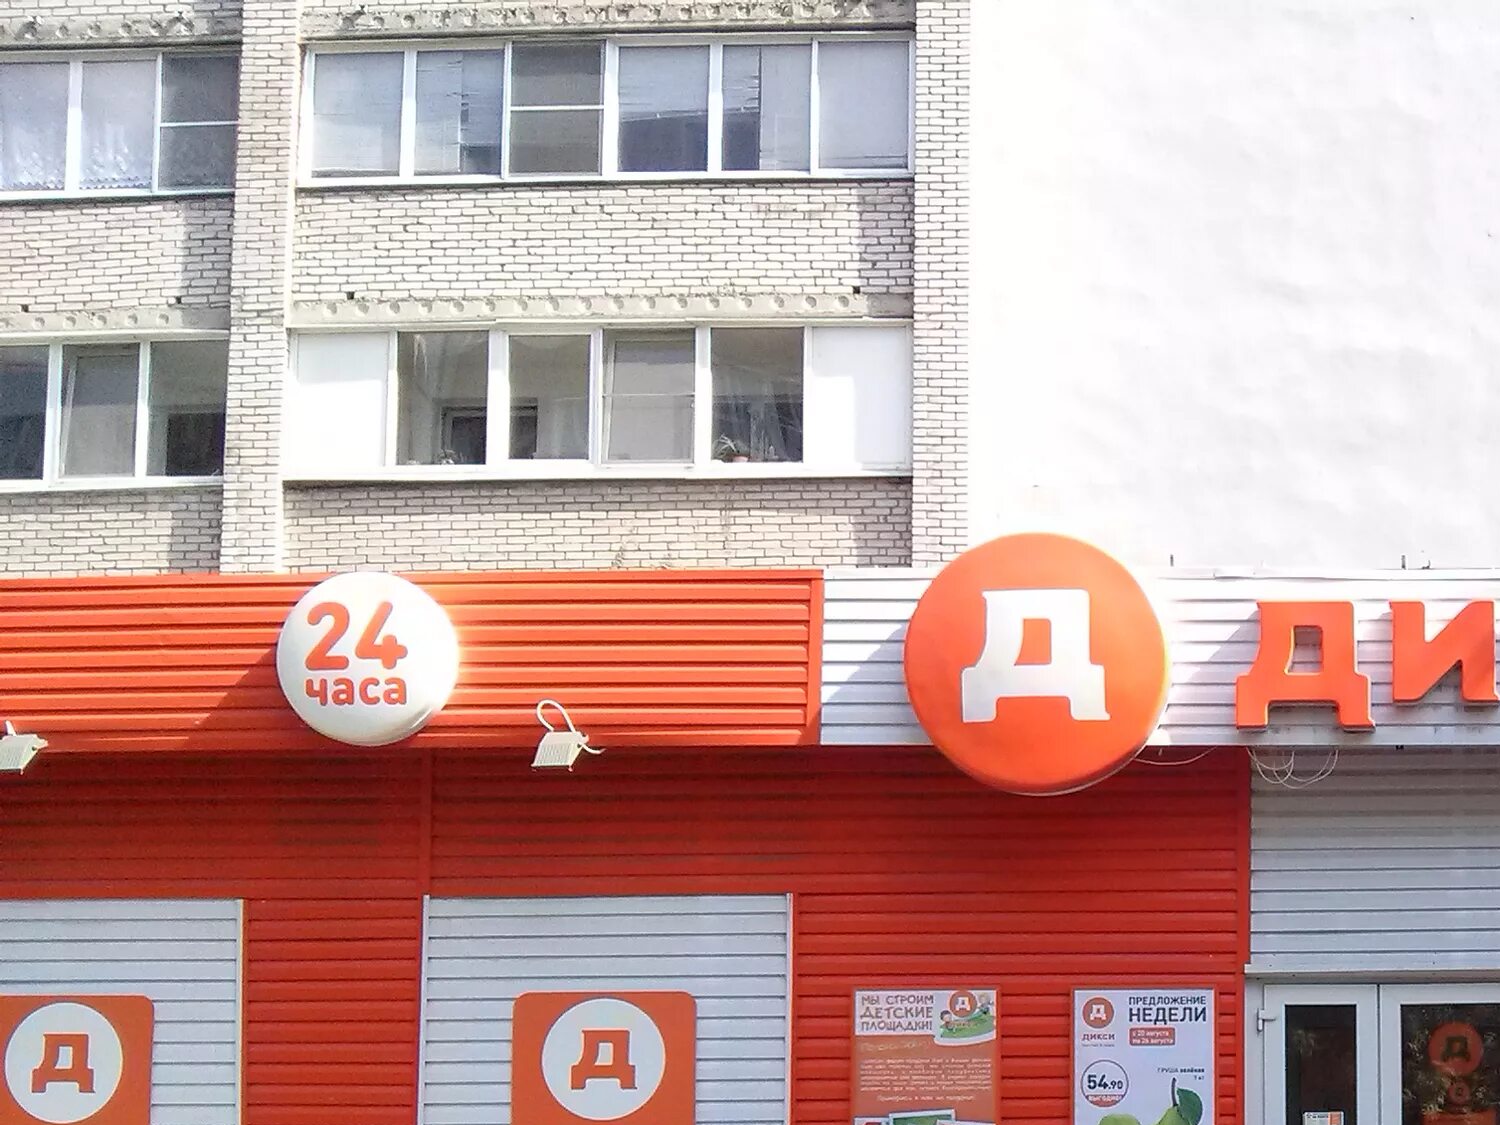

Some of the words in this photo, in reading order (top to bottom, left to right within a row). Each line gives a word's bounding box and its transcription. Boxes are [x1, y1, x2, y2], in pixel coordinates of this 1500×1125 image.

[305, 601, 408, 671] 24
[960, 588, 1110, 723] Д
[305, 677, 407, 706] часа
[861, 995, 880, 1006] МЫ
[886, 994, 934, 1005] СТРОИМ
[1128, 995, 1207, 1006] ПРЕДЛОЖЕНИЕ
[860, 1006, 934, 1019] ДЕТСКИЕ
[1128, 1007, 1207, 1025] НЕДЕЛИ
[861, 1020, 933, 1032] ПЛОЩАДКИ!
[1082, 1033, 1116, 1042] ДИКСИ
[570, 1029, 638, 1090] Д
[1087, 1074, 1124, 1091] 54.90
